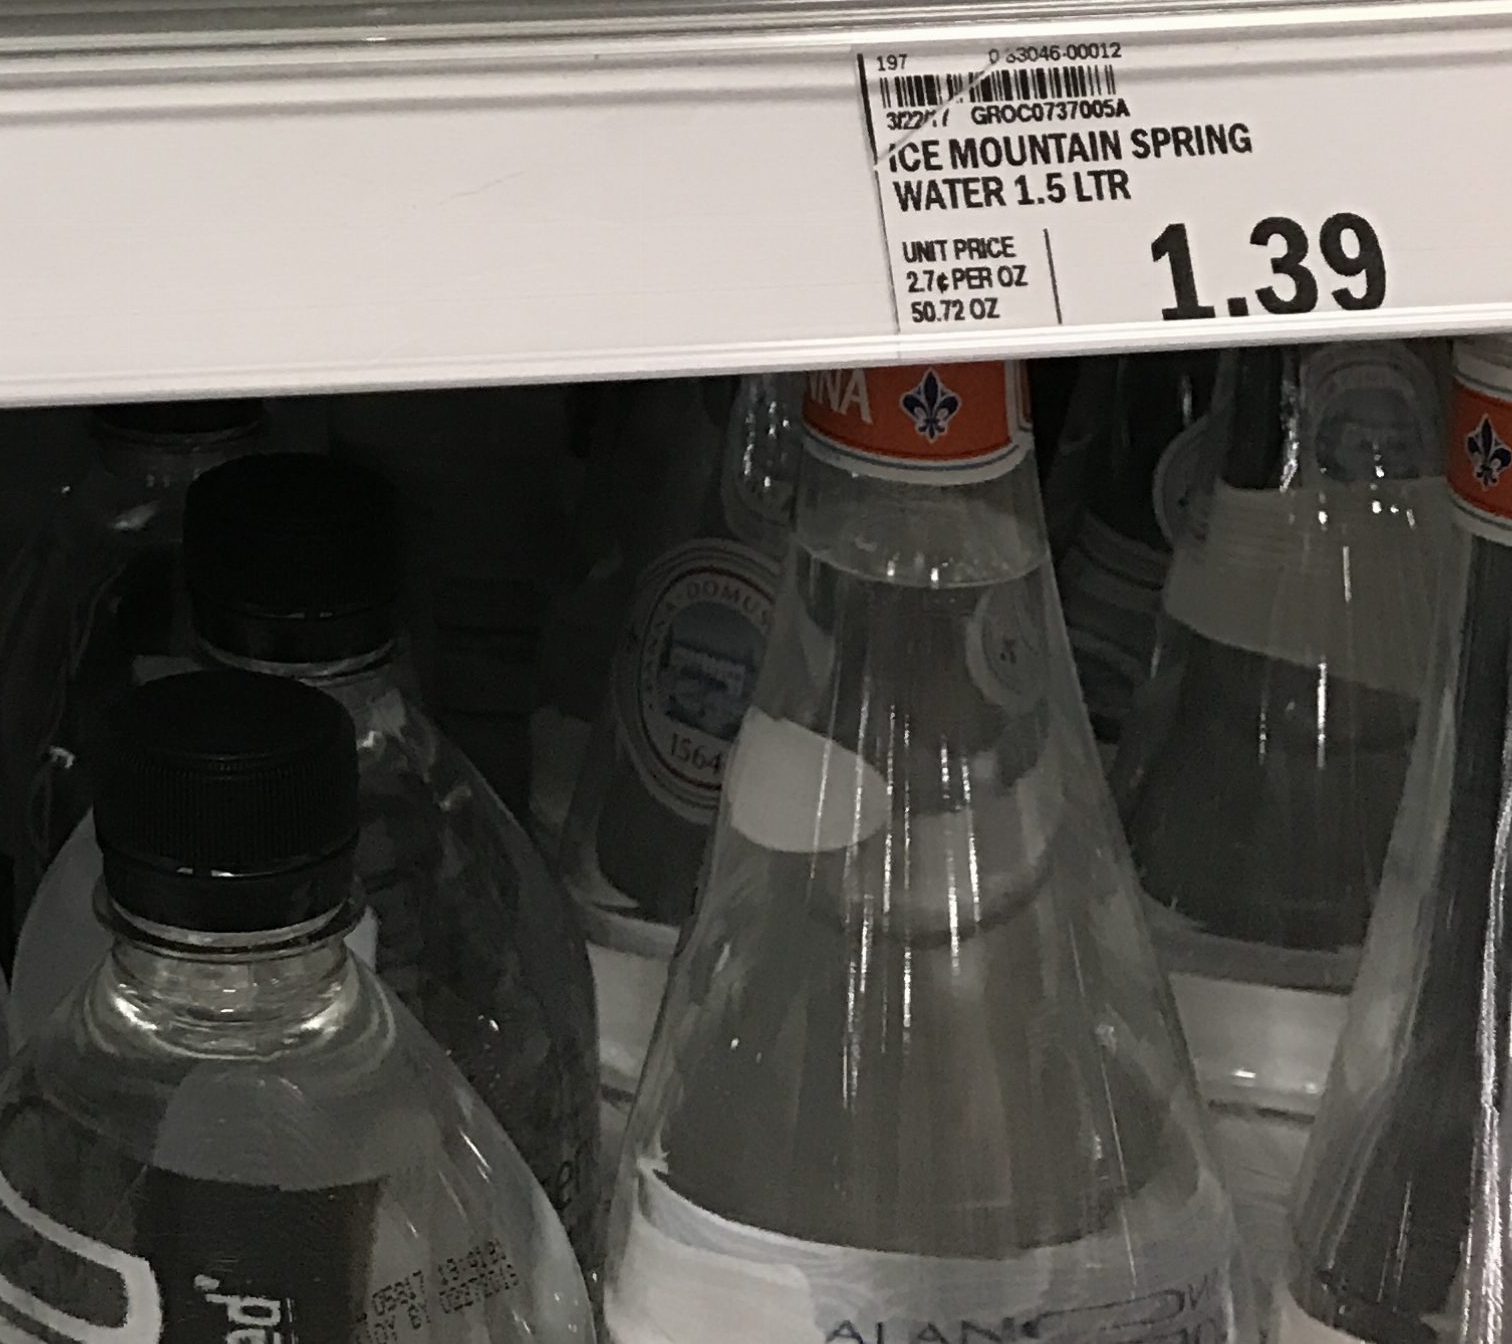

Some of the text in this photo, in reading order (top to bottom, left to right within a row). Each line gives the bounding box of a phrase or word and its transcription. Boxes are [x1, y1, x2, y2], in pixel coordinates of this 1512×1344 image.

[877, 53, 909, 72] 197
[971, 98, 1130, 125] GROC0737005A
[889, 123, 1253, 174] ICE MOUNTAIN SPRING
[894, 169, 1132, 212] WATER 1.5 LTR
[902, 236, 1016, 264] UNIT PRICE
[906, 264, 1029, 294] 2.7¢ PER OZ
[1150, 212, 1387, 321] 1.39
[911, 298, 1001, 323] 50.72 OZ
